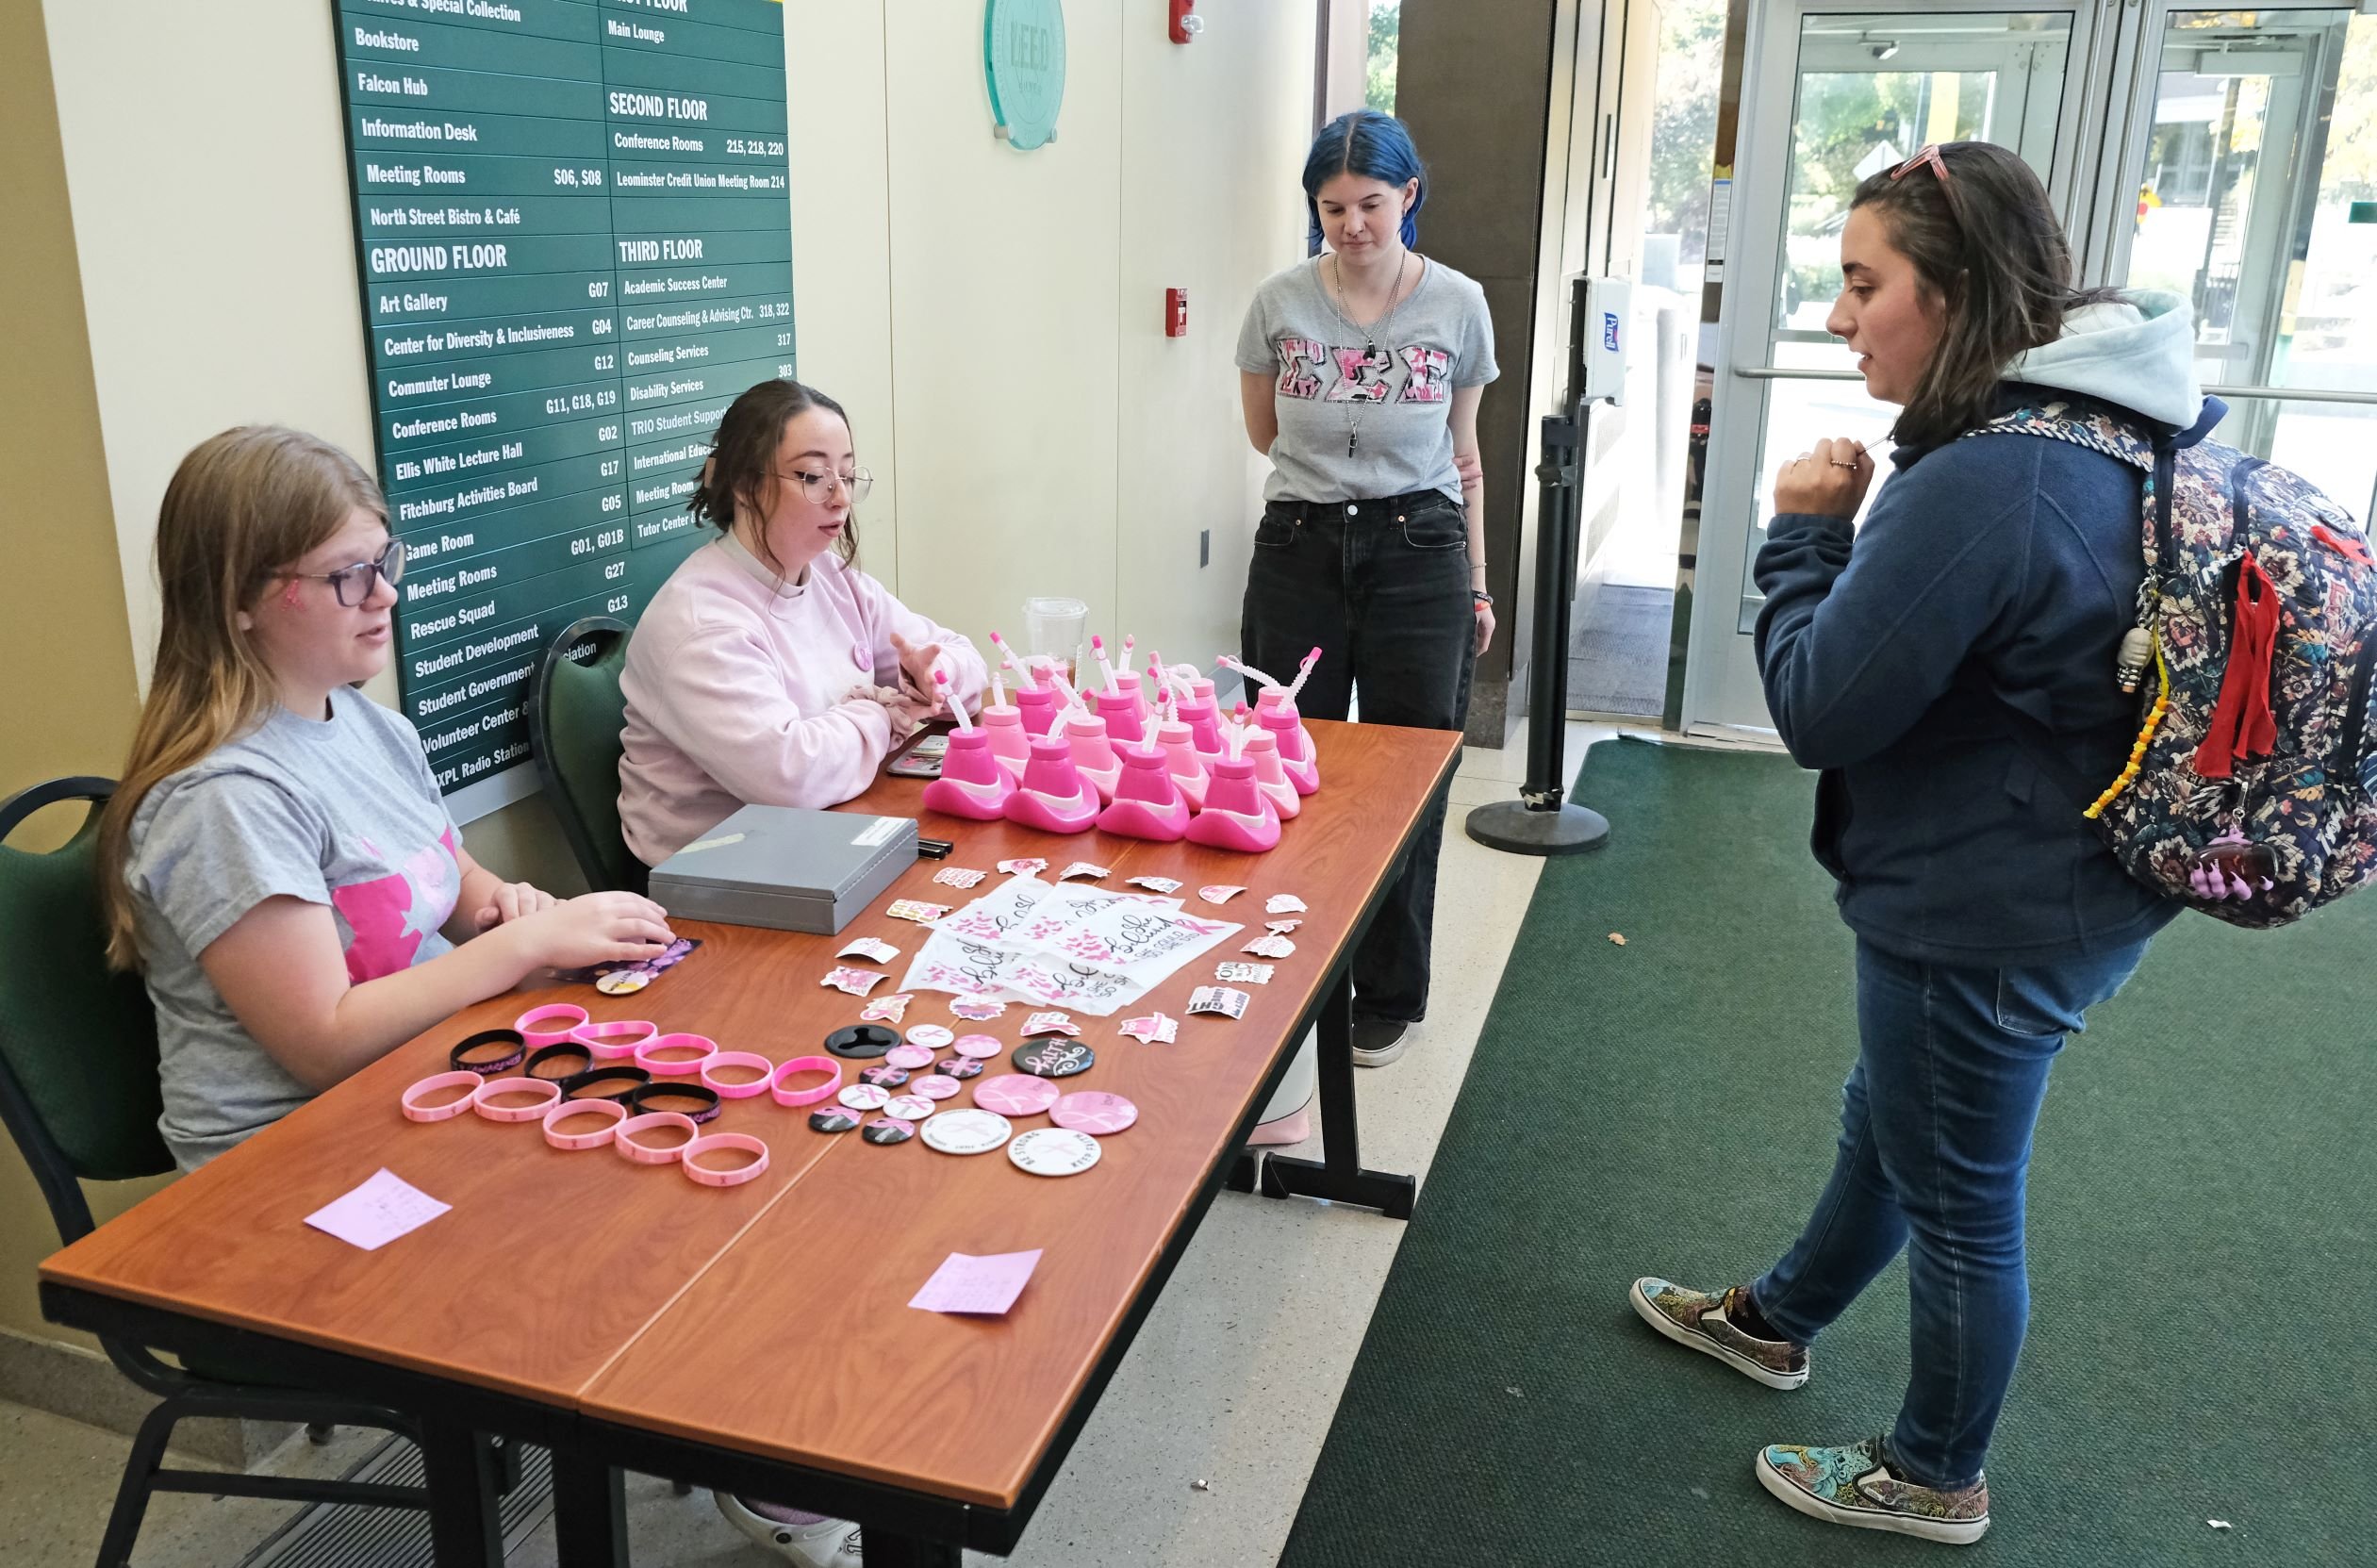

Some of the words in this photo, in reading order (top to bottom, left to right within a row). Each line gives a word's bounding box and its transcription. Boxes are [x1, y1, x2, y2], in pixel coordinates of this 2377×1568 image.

[466, 0, 521, 22] Collection
[355, 27, 420, 52] Bookstore
[608, 20, 631, 38] Main
[633, 24, 665, 43] Lounge
[357, 73, 400, 94] Falcon
[404, 77, 428, 95] Hub
[610, 92, 664, 117] SECOND
[668, 98, 707, 121] FLOOR
[362, 119, 441, 140] Information
[445, 124, 478, 141] Desk
[615, 133, 669, 150] Conference
[672, 137, 703, 152] Rooms
[727, 140, 747, 157] 215,
[748, 140, 767, 157] 218,
[768, 142, 784, 157] 220
[367, 164, 421, 186] Meeting
[424, 166, 466, 184] Rooms
[554, 169, 579, 188] S06,
[582, 169, 602, 186] S08
[617, 173, 665, 188] Leominster
[668, 173, 692, 188] Credit
[694, 173, 716, 188] Union
[718, 174, 748, 190] Meeting
[750, 175, 769, 189] Room
[771, 176, 784, 189] 214
[371, 208, 406, 225] North
[409, 208, 446, 225] Street
[448, 208, 482, 224] Bistro
[485, 210, 494, 224] &
[496, 208, 520, 224] Café
[371, 246, 447, 272] GROUND
[453, 244, 507, 269] FLOOR
[619, 240, 659, 262] THIRD
[663, 239, 703, 260] FLOOR
[380, 296, 400, 313] Art
[404, 293, 448, 312] Gallery
[588, 282, 609, 298] G07
[624, 280, 666, 295] Academic
[667, 278, 701, 293] Success
[702, 276, 728, 289] Center
[626, 316, 655, 331] Career
[656, 311, 701, 329] Counseling
[702, 310, 708, 322] &
[709, 306, 740, 322] Advising
[741, 306, 753, 320] Ctr.
[759, 305, 775, 319] 318,
[776, 303, 790, 316] 322
[385, 338, 424, 356] Center
[427, 334, 444, 351] for
[446, 330, 493, 350] Diversity
[496, 329, 505, 344] &
[508, 324, 573, 343] Inclusiveness
[592, 319, 612, 335] G04
[1606, 317, 1618, 349] Purell
[628, 350, 674, 366] Counseling
[676, 344, 709, 359] Services
[777, 333, 791, 346] 317
[388, 377, 449, 397] Commuter
[452, 372, 491, 389] Lounge
[594, 355, 614, 370] G12
[630, 384, 669, 401] Disability
[670, 379, 703, 395] Services
[778, 364, 792, 377] 303
[392, 416, 457, 439] Conference
[460, 411, 497, 427] Rooms
[546, 398, 569, 415] G11,
[572, 394, 595, 411] G18,
[597, 390, 616, 406] G19
[631, 420, 653, 435] TRIO
[656, 415, 692, 431] Student
[396, 461, 421, 481] Ellis
[422, 454, 456, 474] White
[458, 448, 500, 469] Lecture
[502, 441, 523, 459] Hall
[598, 425, 618, 442] G02
[634, 447, 686, 470] International
[688, 443, 715, 458] Educa
[400, 497, 454, 520] Fitchburg
[457, 486, 505, 507] Activities
[507, 476, 538, 495] Board
[601, 461, 619, 477] G17
[636, 487, 669, 503] Meeting
[671, 481, 694, 494] Room
[406, 542, 437, 561] Game
[441, 534, 474, 552] Room
[602, 494, 621, 512] G05
[637, 522, 660, 537] Tutor
[663, 515, 688, 531] Center
[406, 578, 456, 601] Meeting
[459, 566, 497, 586] Rooms
[571, 539, 595, 555] G01,
[597, 529, 624, 548] G01B
[410, 617, 456, 639] Rescue
[458, 601, 496, 625] Squad
[605, 562, 625, 580] G27
[415, 653, 464, 677] Student
[465, 624, 539, 658] Development
[607, 595, 628, 613] G13
[419, 686, 467, 716] Student
[469, 661, 536, 697] Government
[422, 722, 480, 754] Volunteer
[482, 707, 520, 731] Center
[435, 767, 459, 787] XPL
[462, 755, 491, 778] Radio
[493, 741, 530, 765] Station
